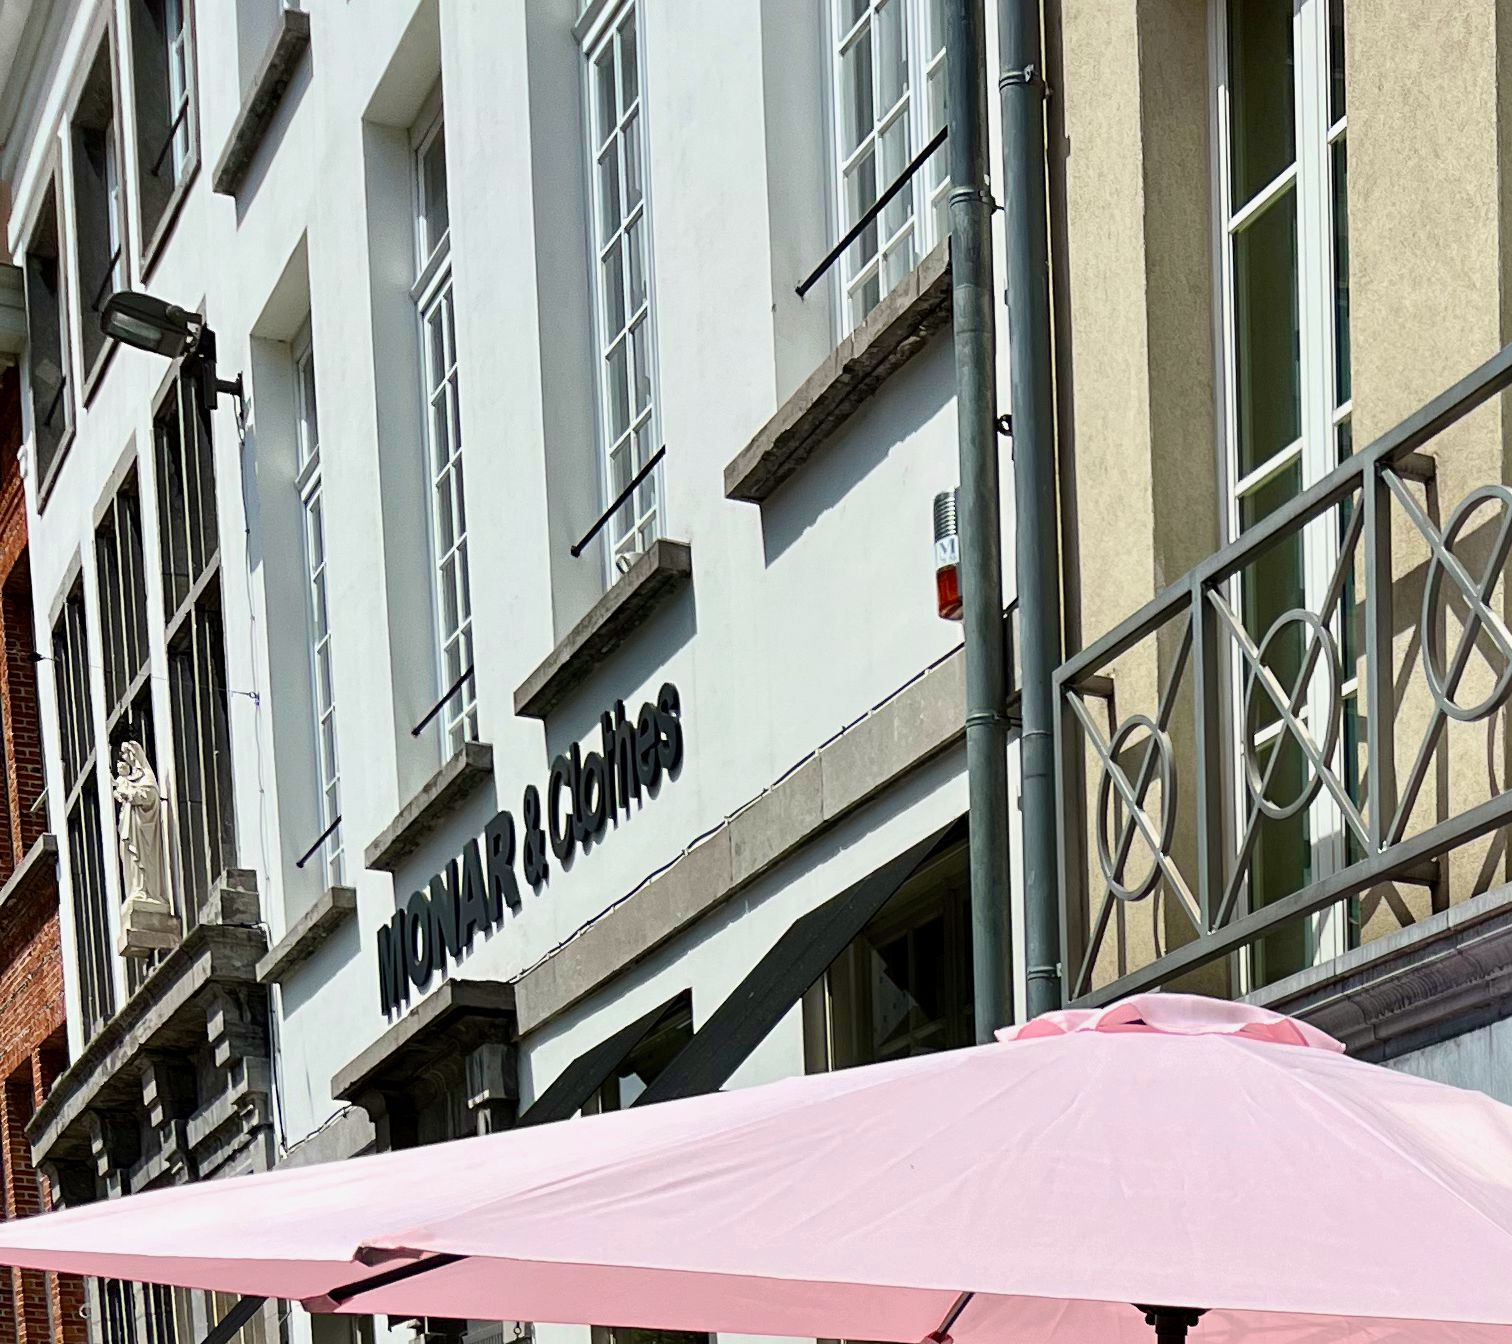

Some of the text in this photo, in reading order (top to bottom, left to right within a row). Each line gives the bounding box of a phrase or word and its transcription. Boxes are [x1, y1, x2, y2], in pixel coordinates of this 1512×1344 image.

[377, 682, 684, 1020] MONAR & Clothes
